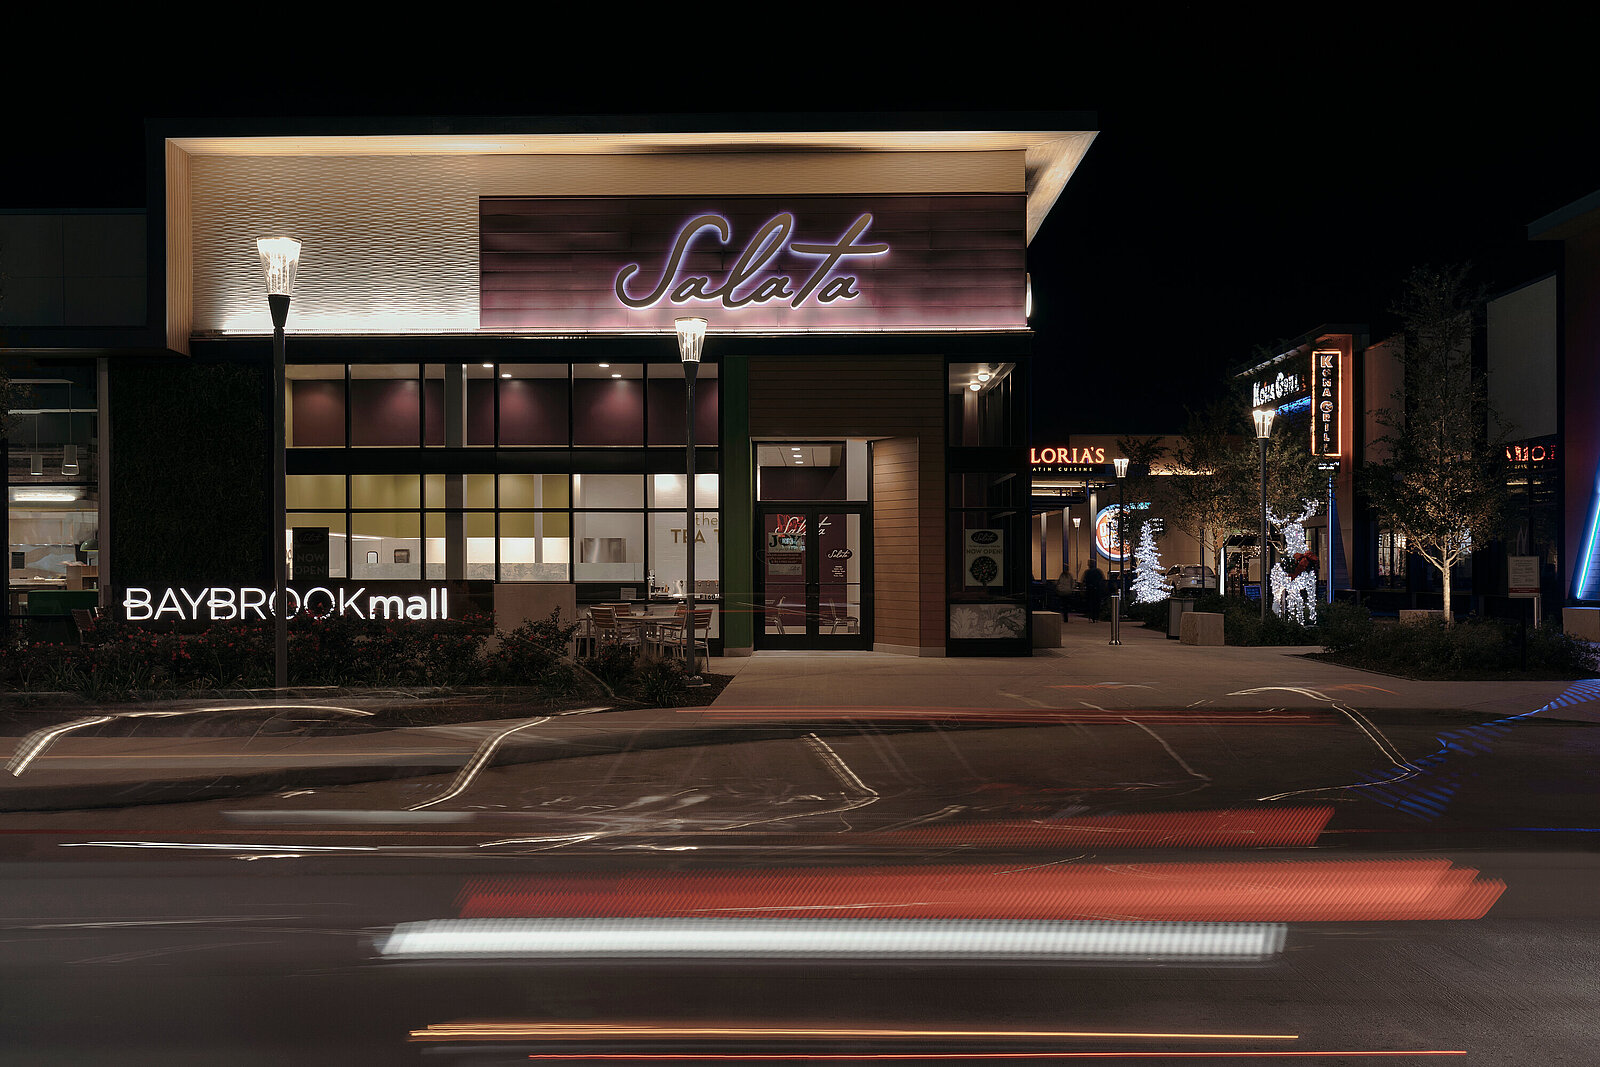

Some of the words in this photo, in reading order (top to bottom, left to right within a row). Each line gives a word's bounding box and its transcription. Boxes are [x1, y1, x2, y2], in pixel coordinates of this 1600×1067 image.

[615, 213, 889, 310] Salata
[1320, 355, 1334, 397] KONA
[1030, 446, 1105, 464] LORIA'S
[297, 553, 325, 562] NOW
